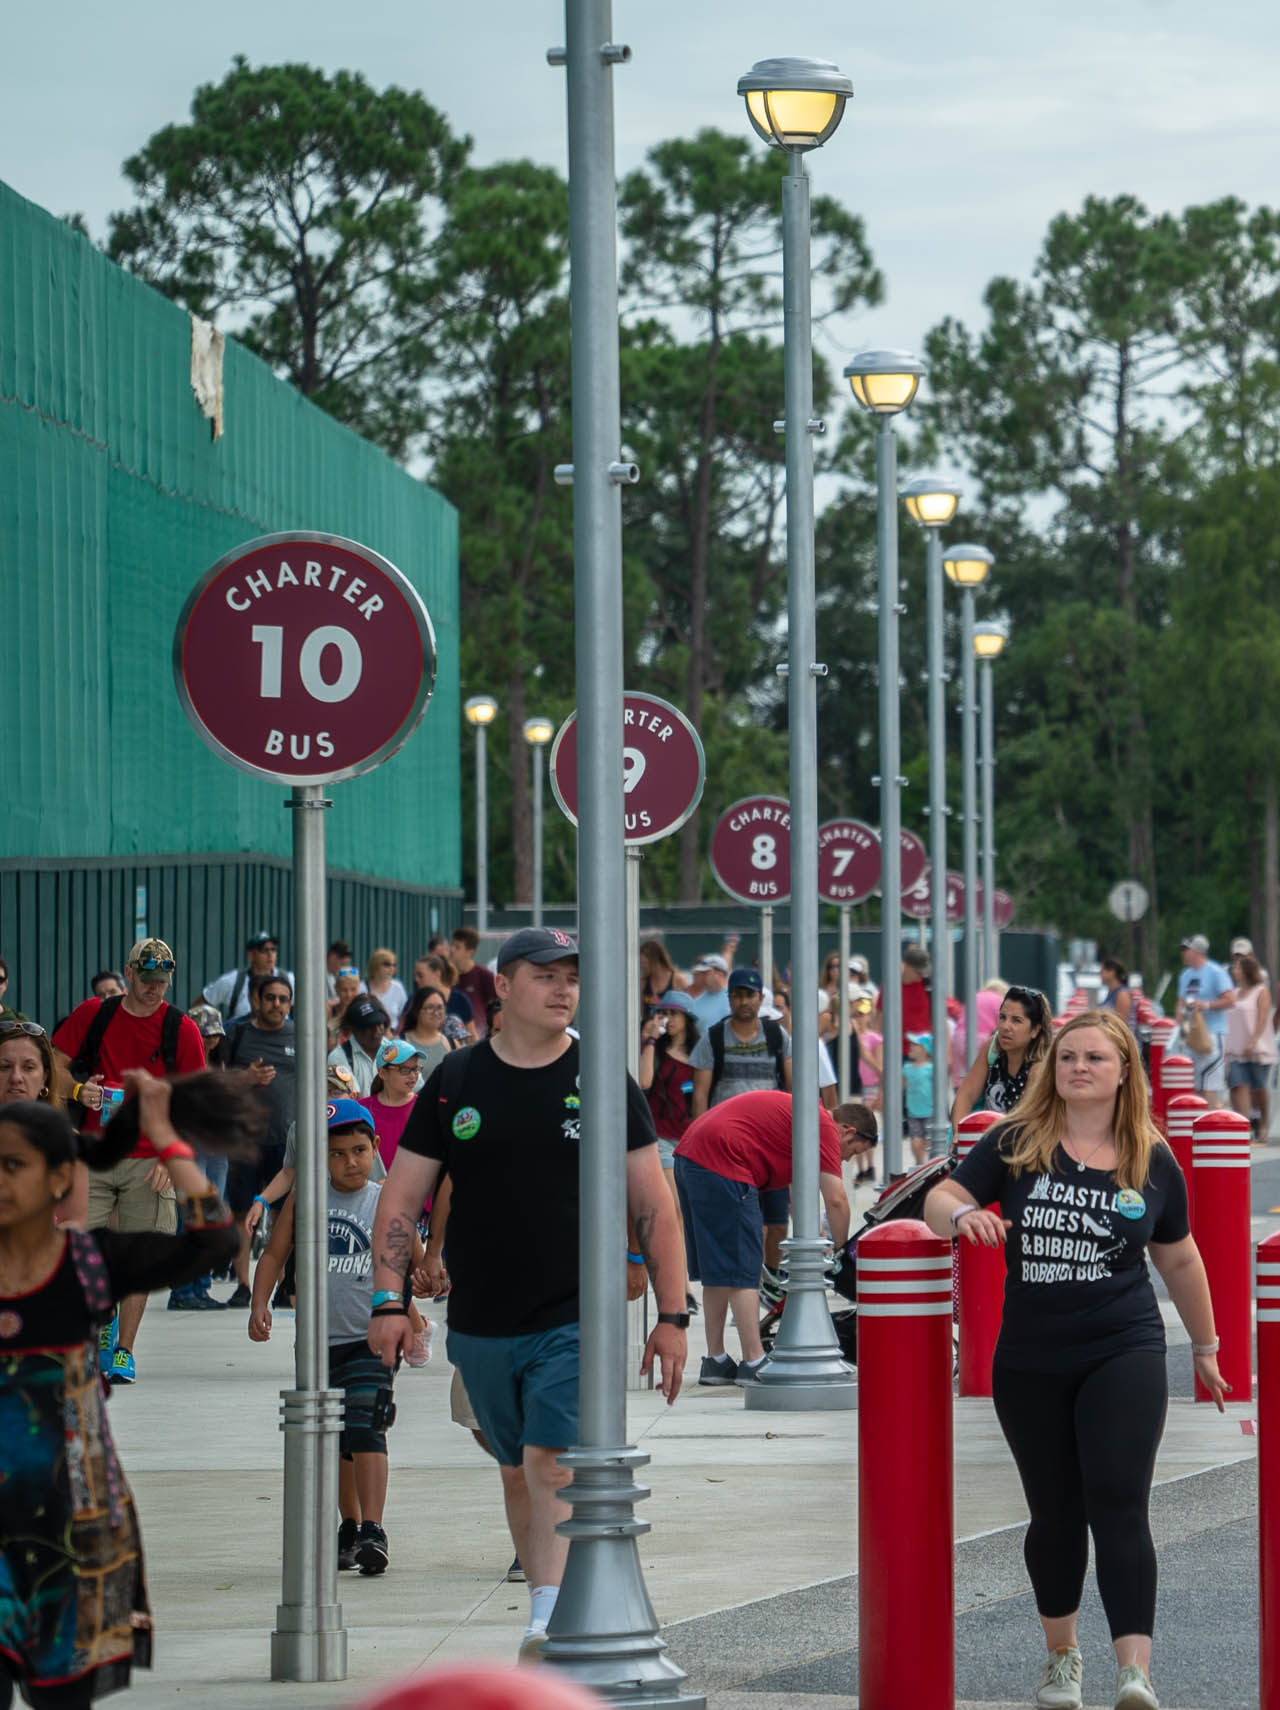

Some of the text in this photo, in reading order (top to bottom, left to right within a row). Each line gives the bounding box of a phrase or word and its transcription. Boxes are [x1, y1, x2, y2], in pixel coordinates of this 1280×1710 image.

[225, 560, 385, 622] CHARTER
[251, 624, 363, 704] 10
[624, 708, 673, 742] RTER
[264, 728, 335, 761] BUS
[624, 811, 651, 830] US
[729, 807, 791, 832] CHARTE
[751, 834, 777, 870] 8
[832, 848, 855, 877] 7
[750, 881, 778, 896] BUS
[830, 885, 855, 898] BUS
[1021, 1205, 1081, 1233] SHOES
[327, 1252, 373, 1275] PIONS
